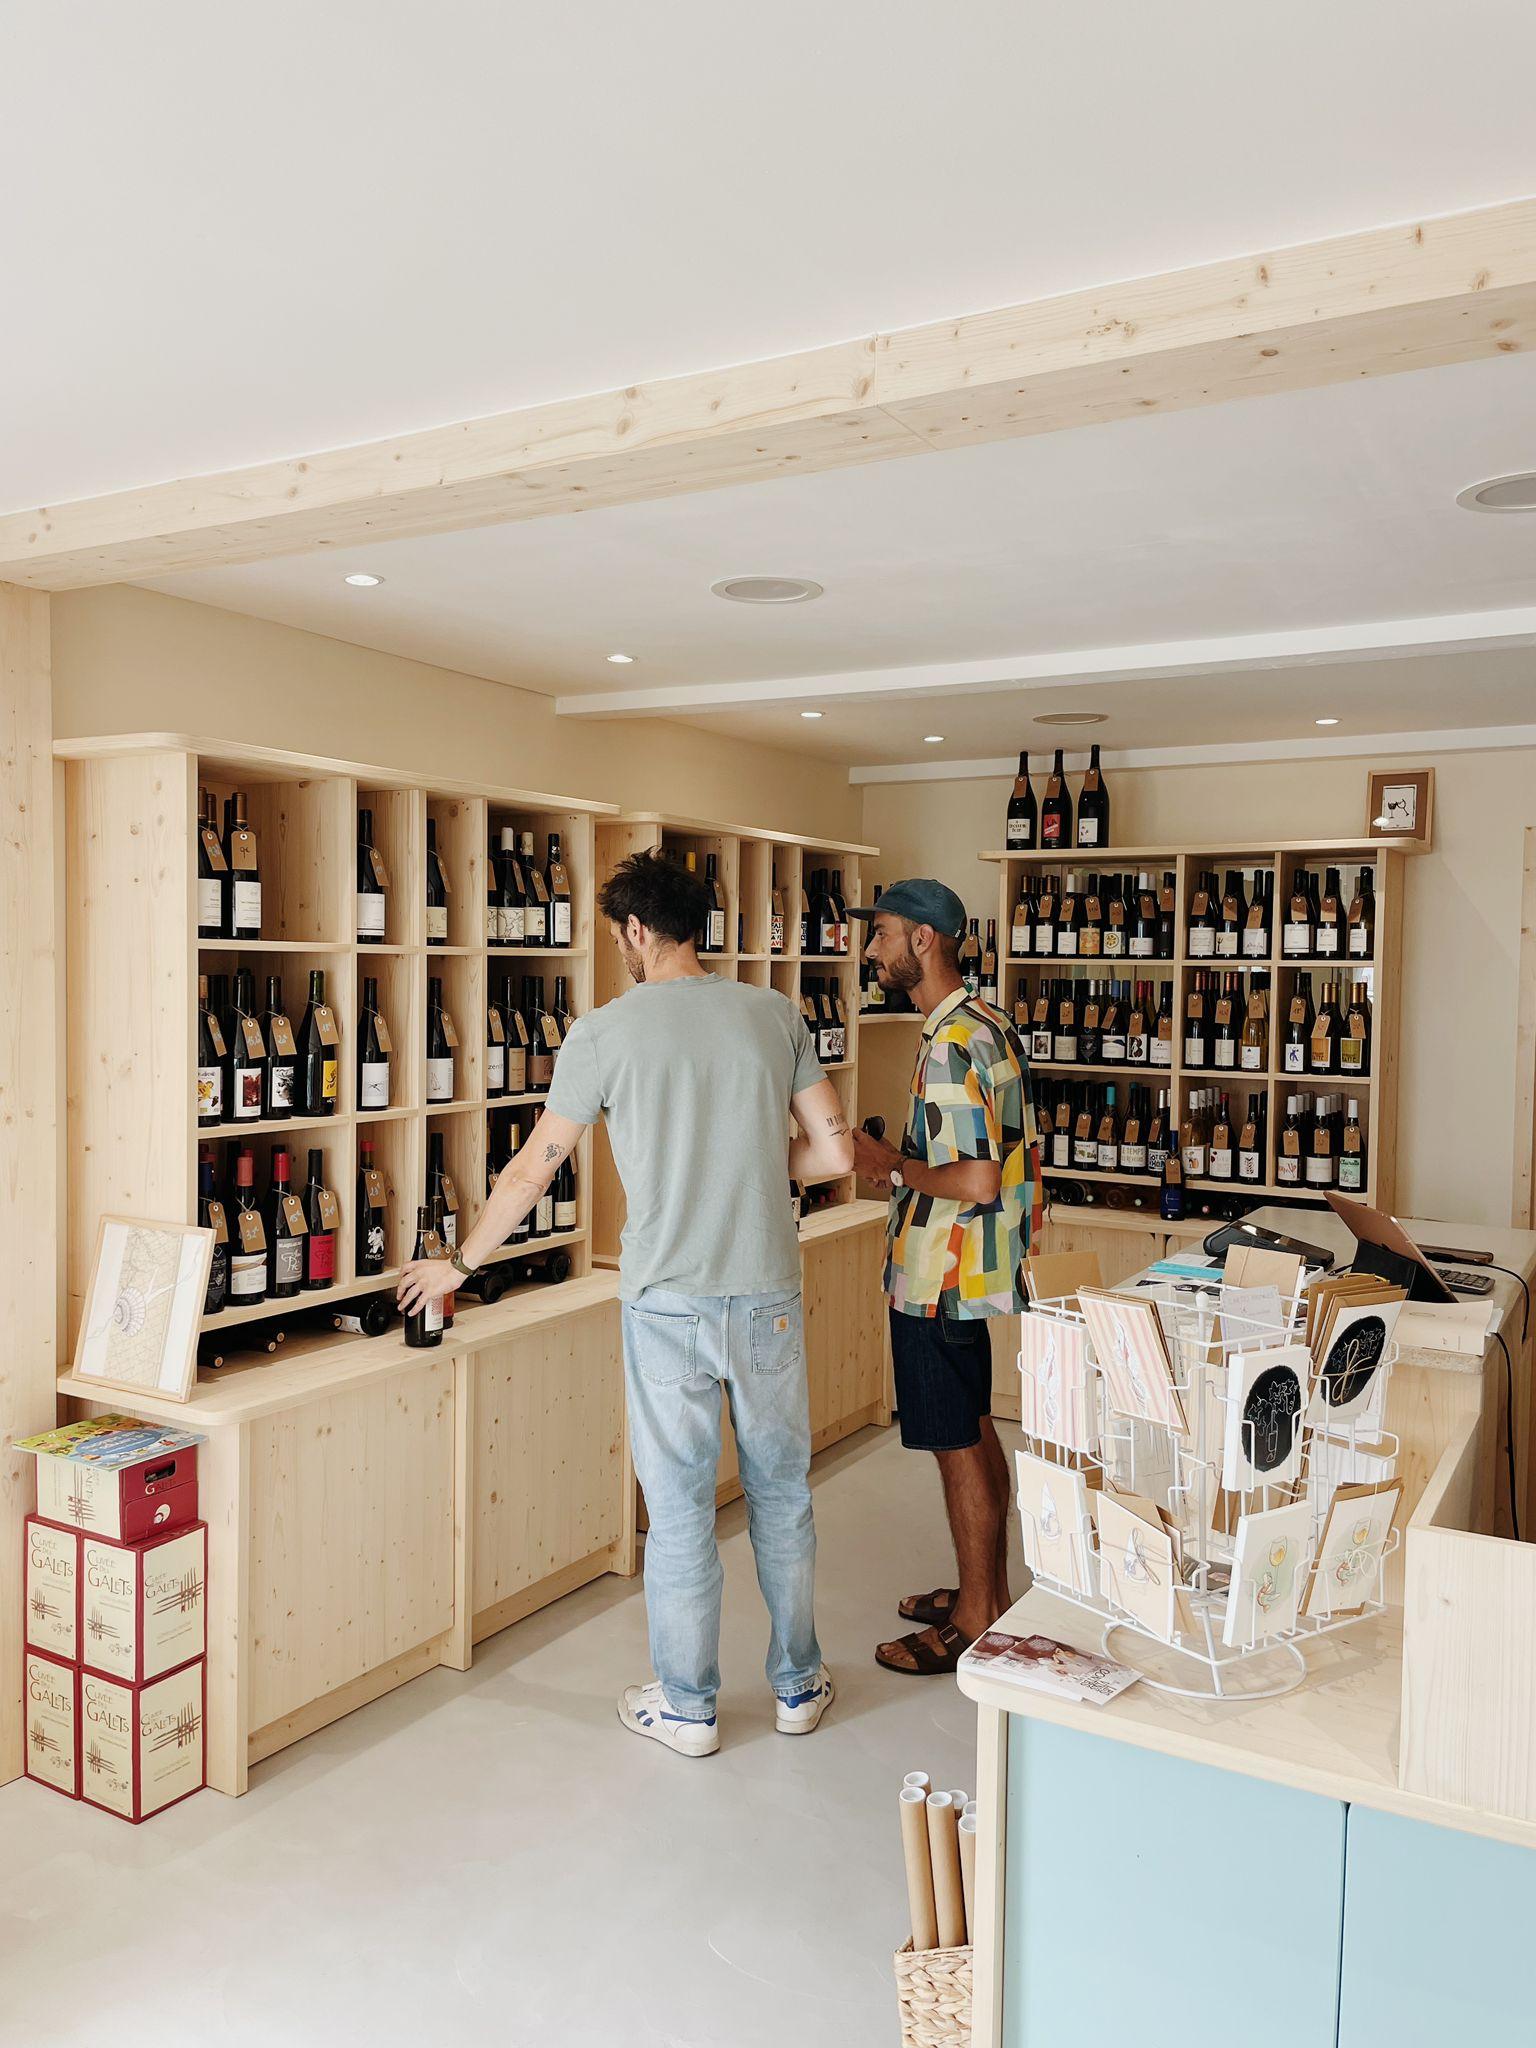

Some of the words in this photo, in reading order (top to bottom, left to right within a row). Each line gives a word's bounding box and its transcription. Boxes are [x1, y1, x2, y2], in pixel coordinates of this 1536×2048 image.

[31, 1548, 74, 1577] GALETS
[87, 1567, 133, 1596] GALETS
[30, 1681, 72, 1712] GALETS
[86, 1701, 130, 1733] GALETS
